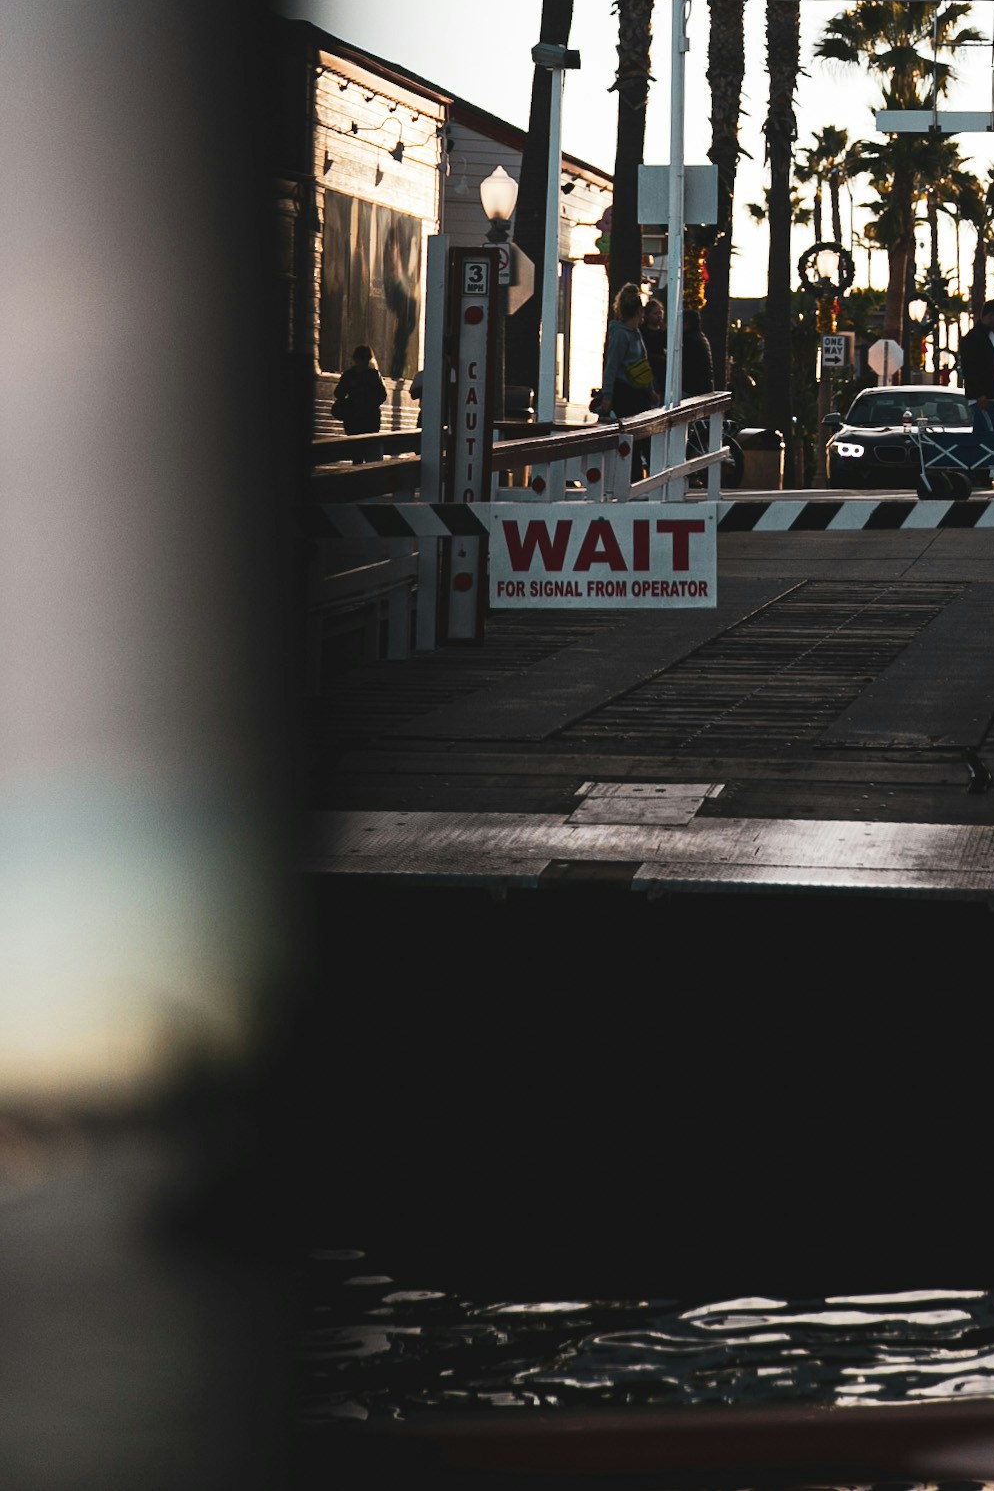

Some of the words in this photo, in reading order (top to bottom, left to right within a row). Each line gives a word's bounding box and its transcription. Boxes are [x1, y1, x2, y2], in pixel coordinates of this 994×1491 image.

[468, 265, 484, 283] 3
[467, 284, 484, 292] MPH
[824, 337, 843, 346] ONE
[824, 347, 843, 355] WAY
[463, 362, 478, 503] CAUTIO
[502, 519, 706, 572] WAIT
[497, 580, 526, 598] FOR
[530, 580, 583, 598] SIGNAL
[587, 580, 627, 598] FROM
[631, 580, 709, 598] OPERATOR
